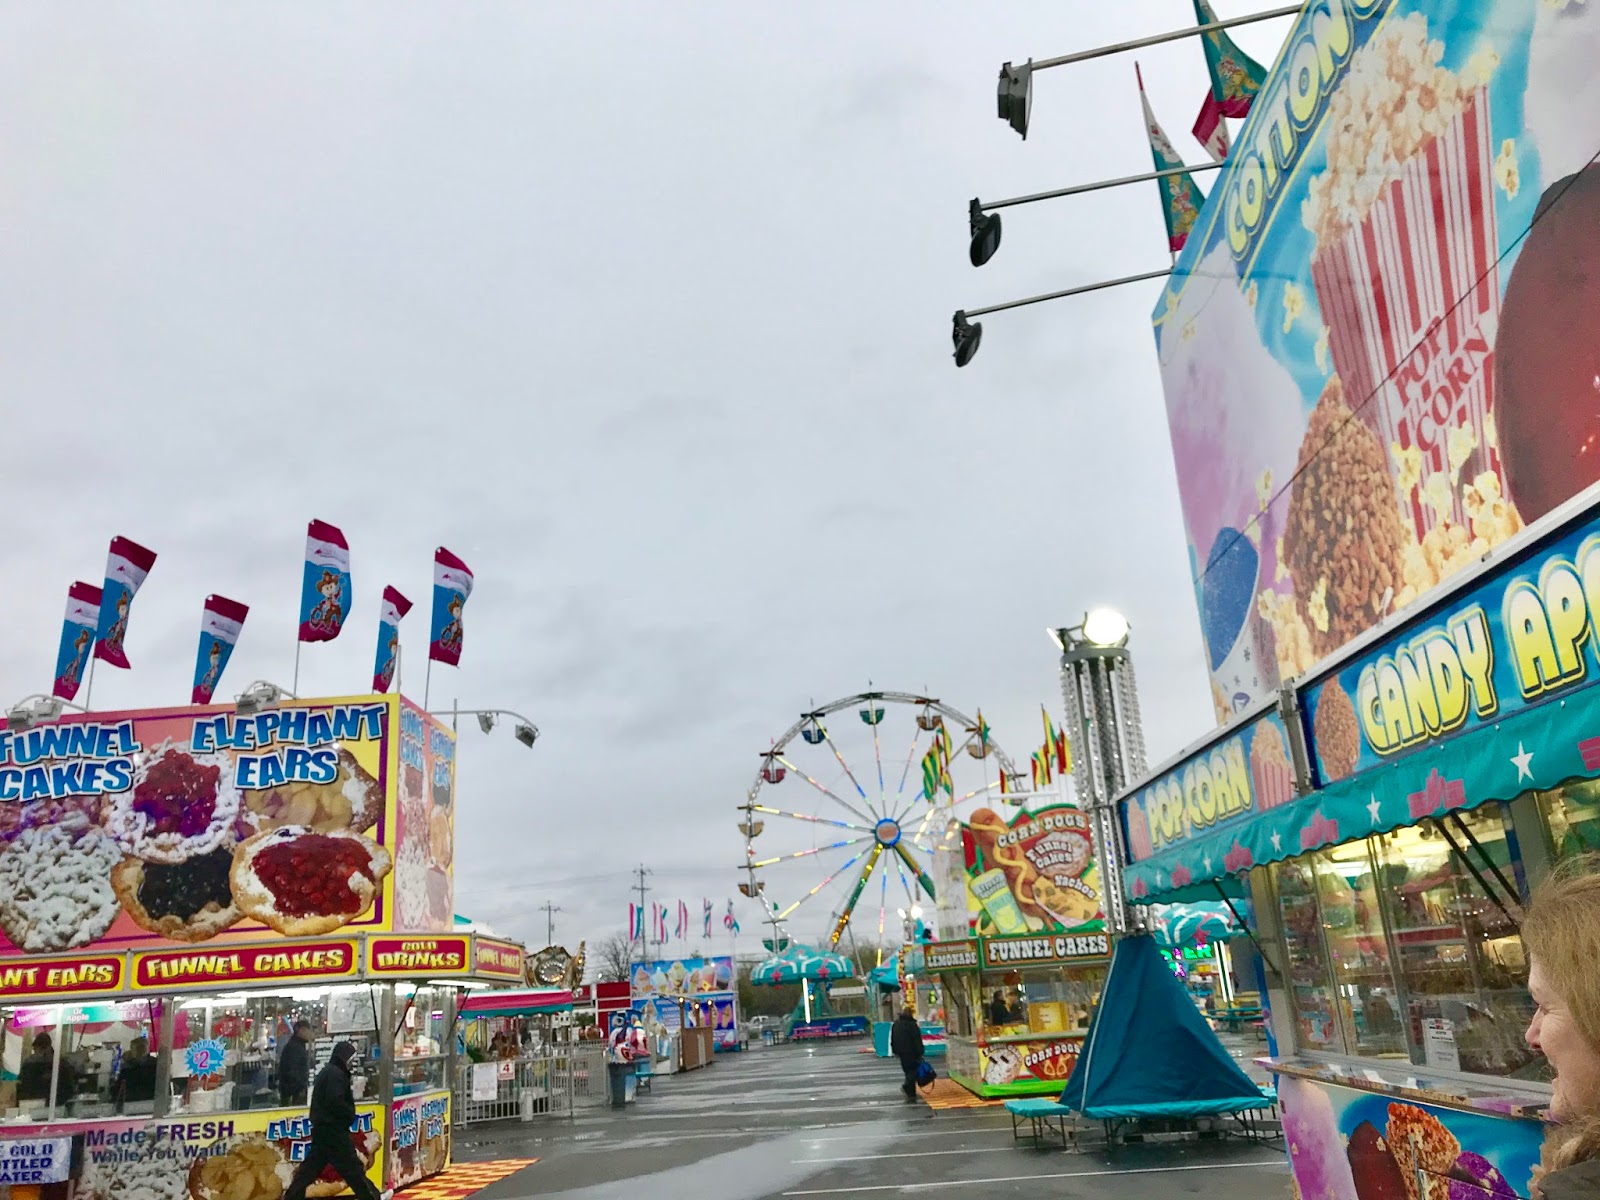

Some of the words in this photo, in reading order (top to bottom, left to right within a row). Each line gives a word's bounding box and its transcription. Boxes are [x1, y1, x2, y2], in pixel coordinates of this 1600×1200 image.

[1227, 0, 1351, 256] COTTON
[1396, 316, 1441, 406] POP
[1416, 322, 1489, 452] CORN
[1361, 605, 1498, 756] CANDY
[0, 720, 142, 766] FUNNEL
[190, 703, 387, 753] ELEPHANT
[0, 757, 134, 802] CAKES
[235, 748, 339, 790] EARS
[1145, 782, 1184, 848] POP
[1183, 738, 1253, 829] CORN
[998, 821, 1040, 848] CORN
[1043, 813, 1086, 831] DOGS
[401, 941, 437, 951] COLD
[988, 939, 1053, 962] FUNNEL
[1054, 935, 1108, 957] CAKES
[145, 953, 244, 980] FUNNEL
[253, 948, 345, 973] CAKES
[376, 951, 461, 968] DRINKS
[927, 952, 978, 968] LEMONADE
[0, 968, 39, 988] NT
[46, 963, 115, 987] EARS
[502, 1063, 511, 1073] 4
[1025, 1047, 1053, 1067] CORN
[86, 1128, 147, 1147] Made
[156, 1121, 234, 1141] FRESH
[10, 1143, 53, 1157] COLD
[92, 1149, 139, 1163] While
[146, 1147, 177, 1160] You
[0, 1157, 53, 1170] TTLED
